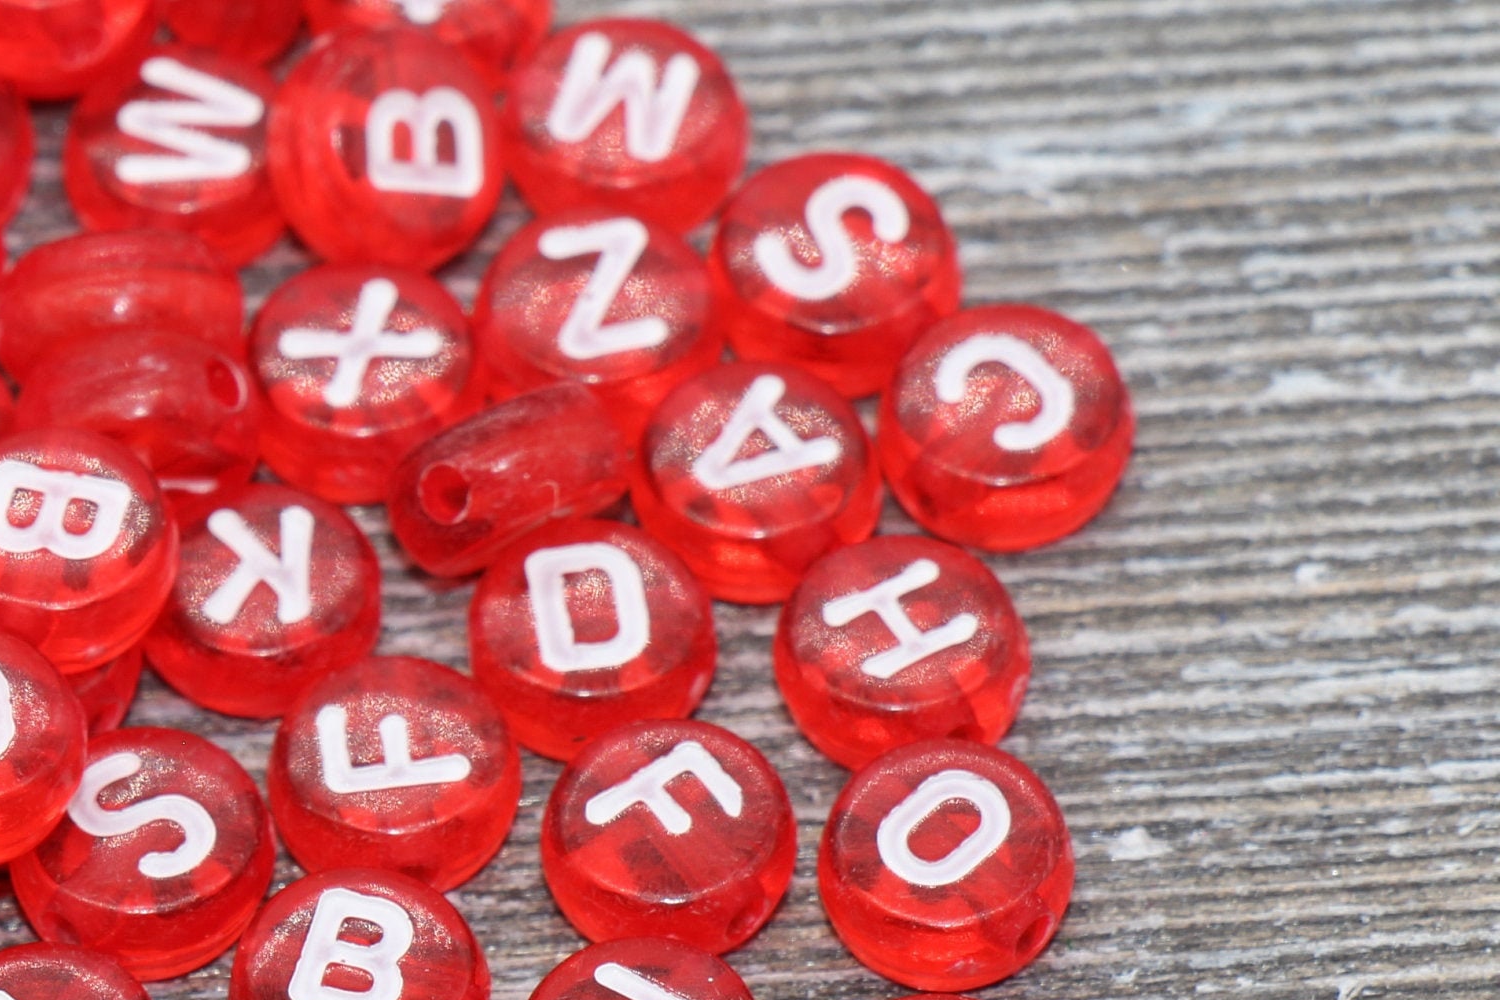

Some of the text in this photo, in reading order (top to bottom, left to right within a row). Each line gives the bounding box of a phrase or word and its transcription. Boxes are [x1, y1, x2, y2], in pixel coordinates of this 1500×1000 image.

[115, 58, 264, 185] W
[365, 87, 484, 198] B
[538, 217, 671, 361] Z
[749, 174, 910, 301] S
[277, 278, 447, 409] X
[931, 331, 1076, 452] C
[690, 374, 843, 493] A
[200, 505, 315, 626] K
[524, 542, 651, 674] D
[821, 558, 980, 680] H
[314, 703, 472, 795] F
[584, 740, 744, 836] F
[67, 750, 217, 880] S
[876, 769, 1012, 889] O
